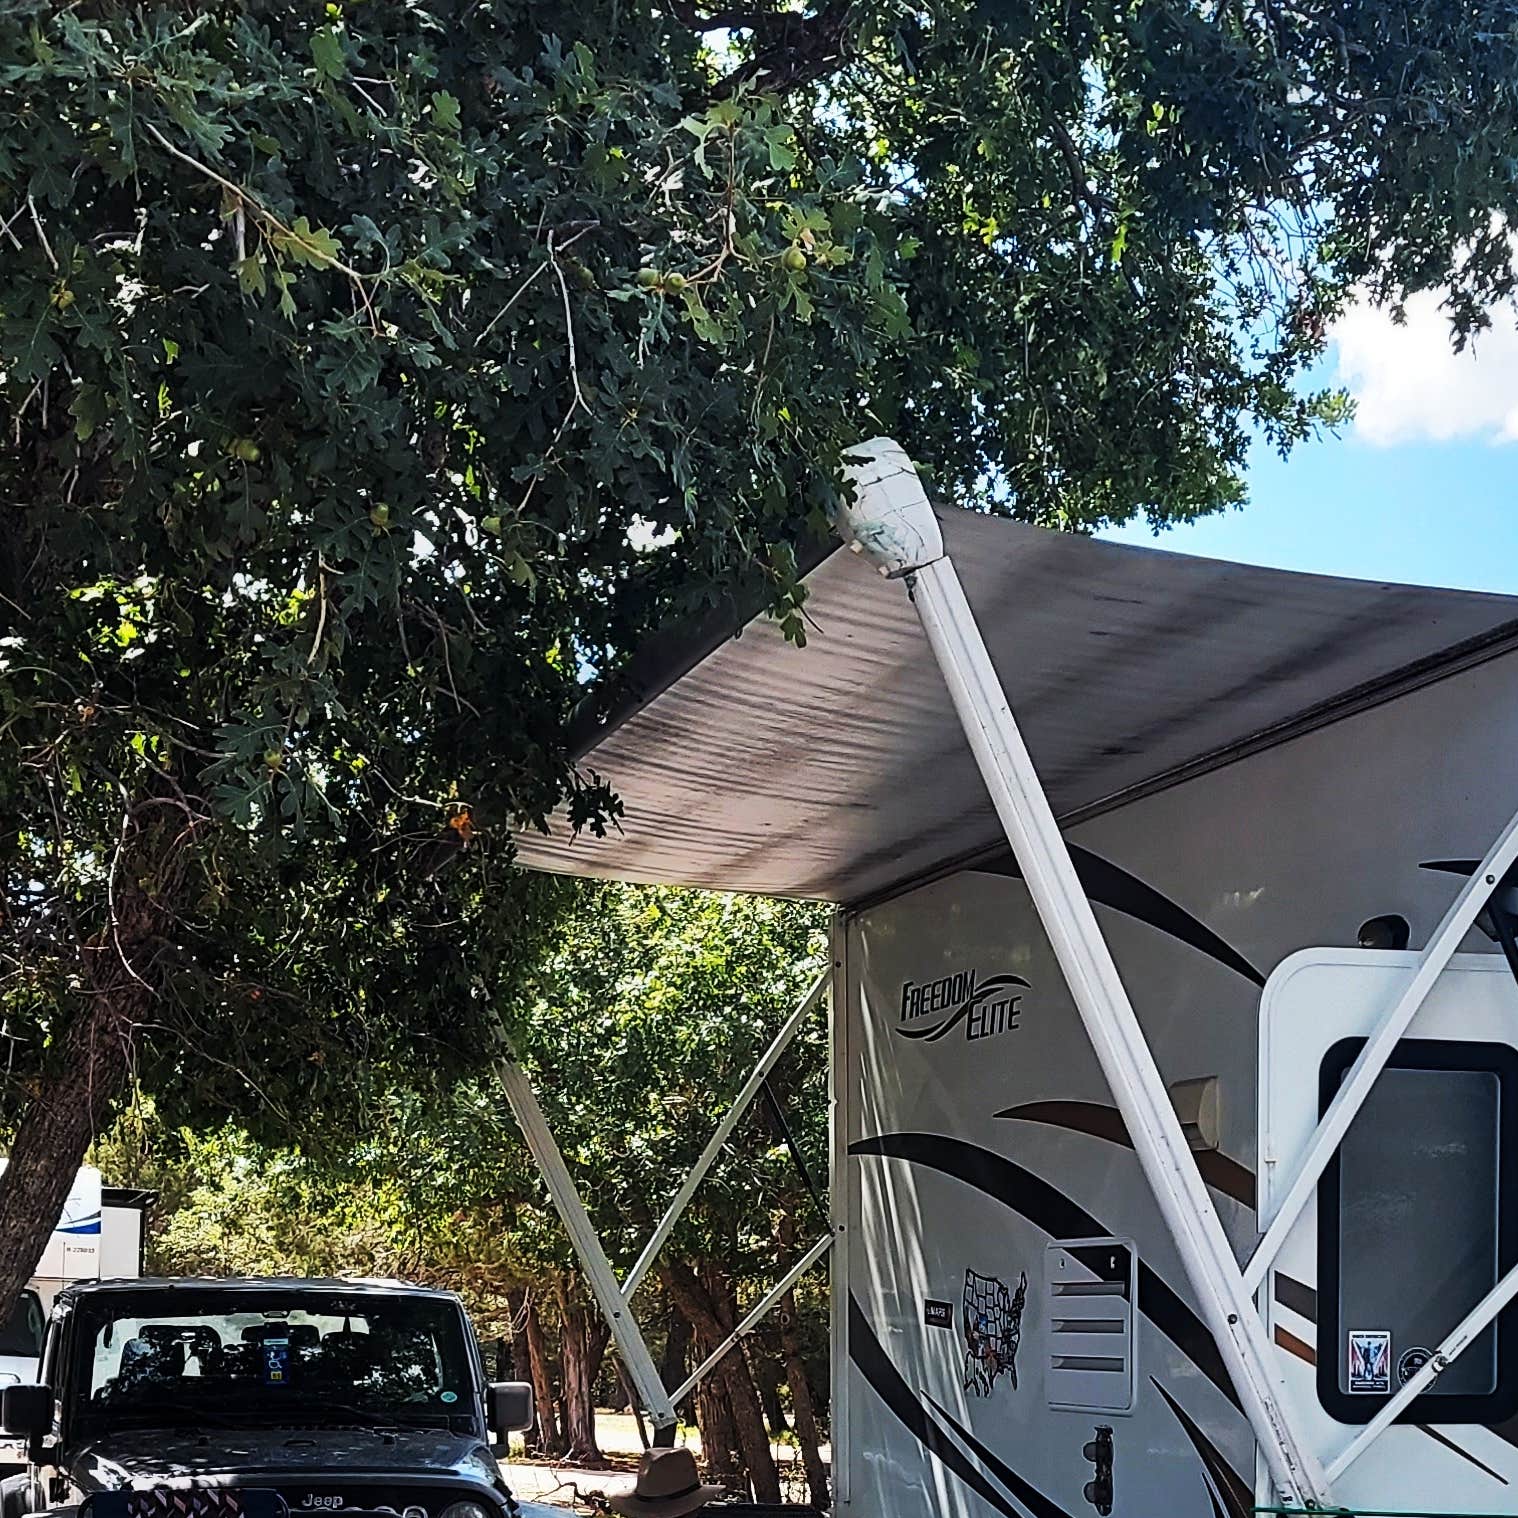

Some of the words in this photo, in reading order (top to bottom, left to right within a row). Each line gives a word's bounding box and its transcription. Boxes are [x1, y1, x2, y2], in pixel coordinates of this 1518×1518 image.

[900, 968, 976, 1022] FREEDOM
[966, 995, 1022, 1041] ELITE
[301, 1493, 344, 1509] Jeep
